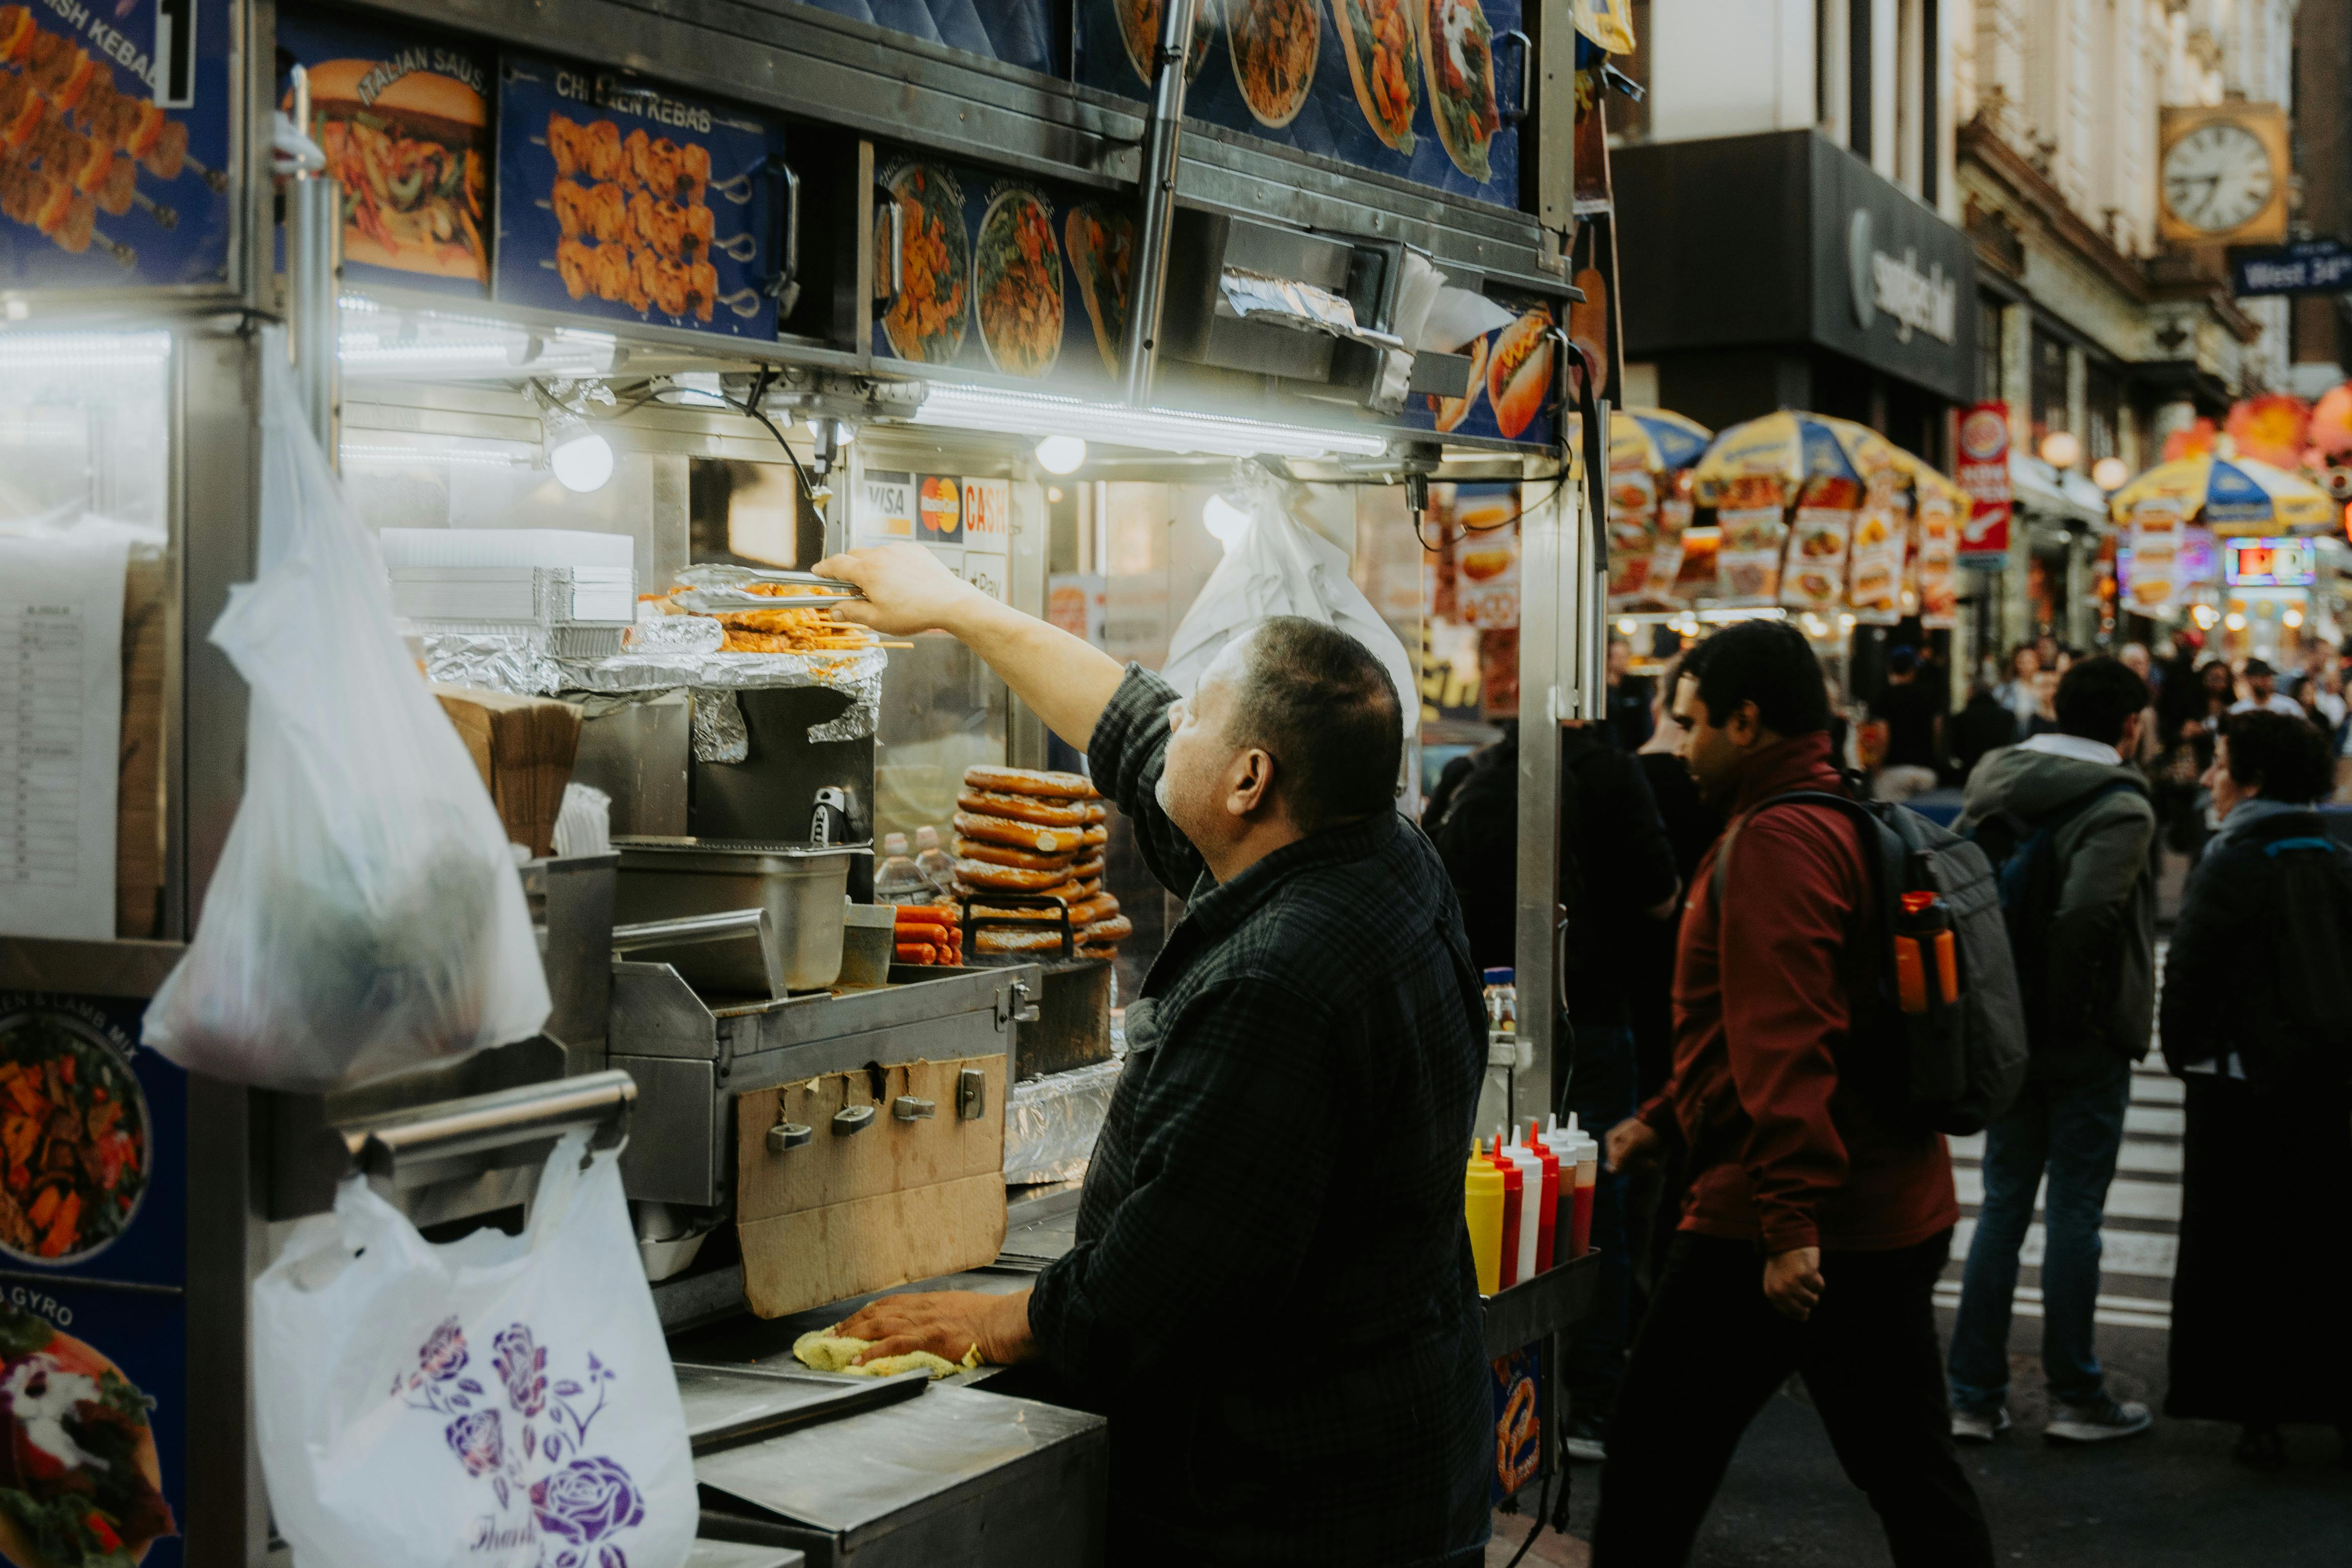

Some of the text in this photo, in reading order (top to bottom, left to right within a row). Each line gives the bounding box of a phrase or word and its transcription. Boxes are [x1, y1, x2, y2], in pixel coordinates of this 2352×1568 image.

[43, 0, 90, 30] SH
[357, 47, 428, 108] ITALIAN
[556, 71, 642, 117] CHIEN
[868, 486, 905, 515] VISA
[966, 485, 1006, 534] CASH
[53, 992, 108, 1029] LAMB
[11, 1286, 74, 1327] GYRO
